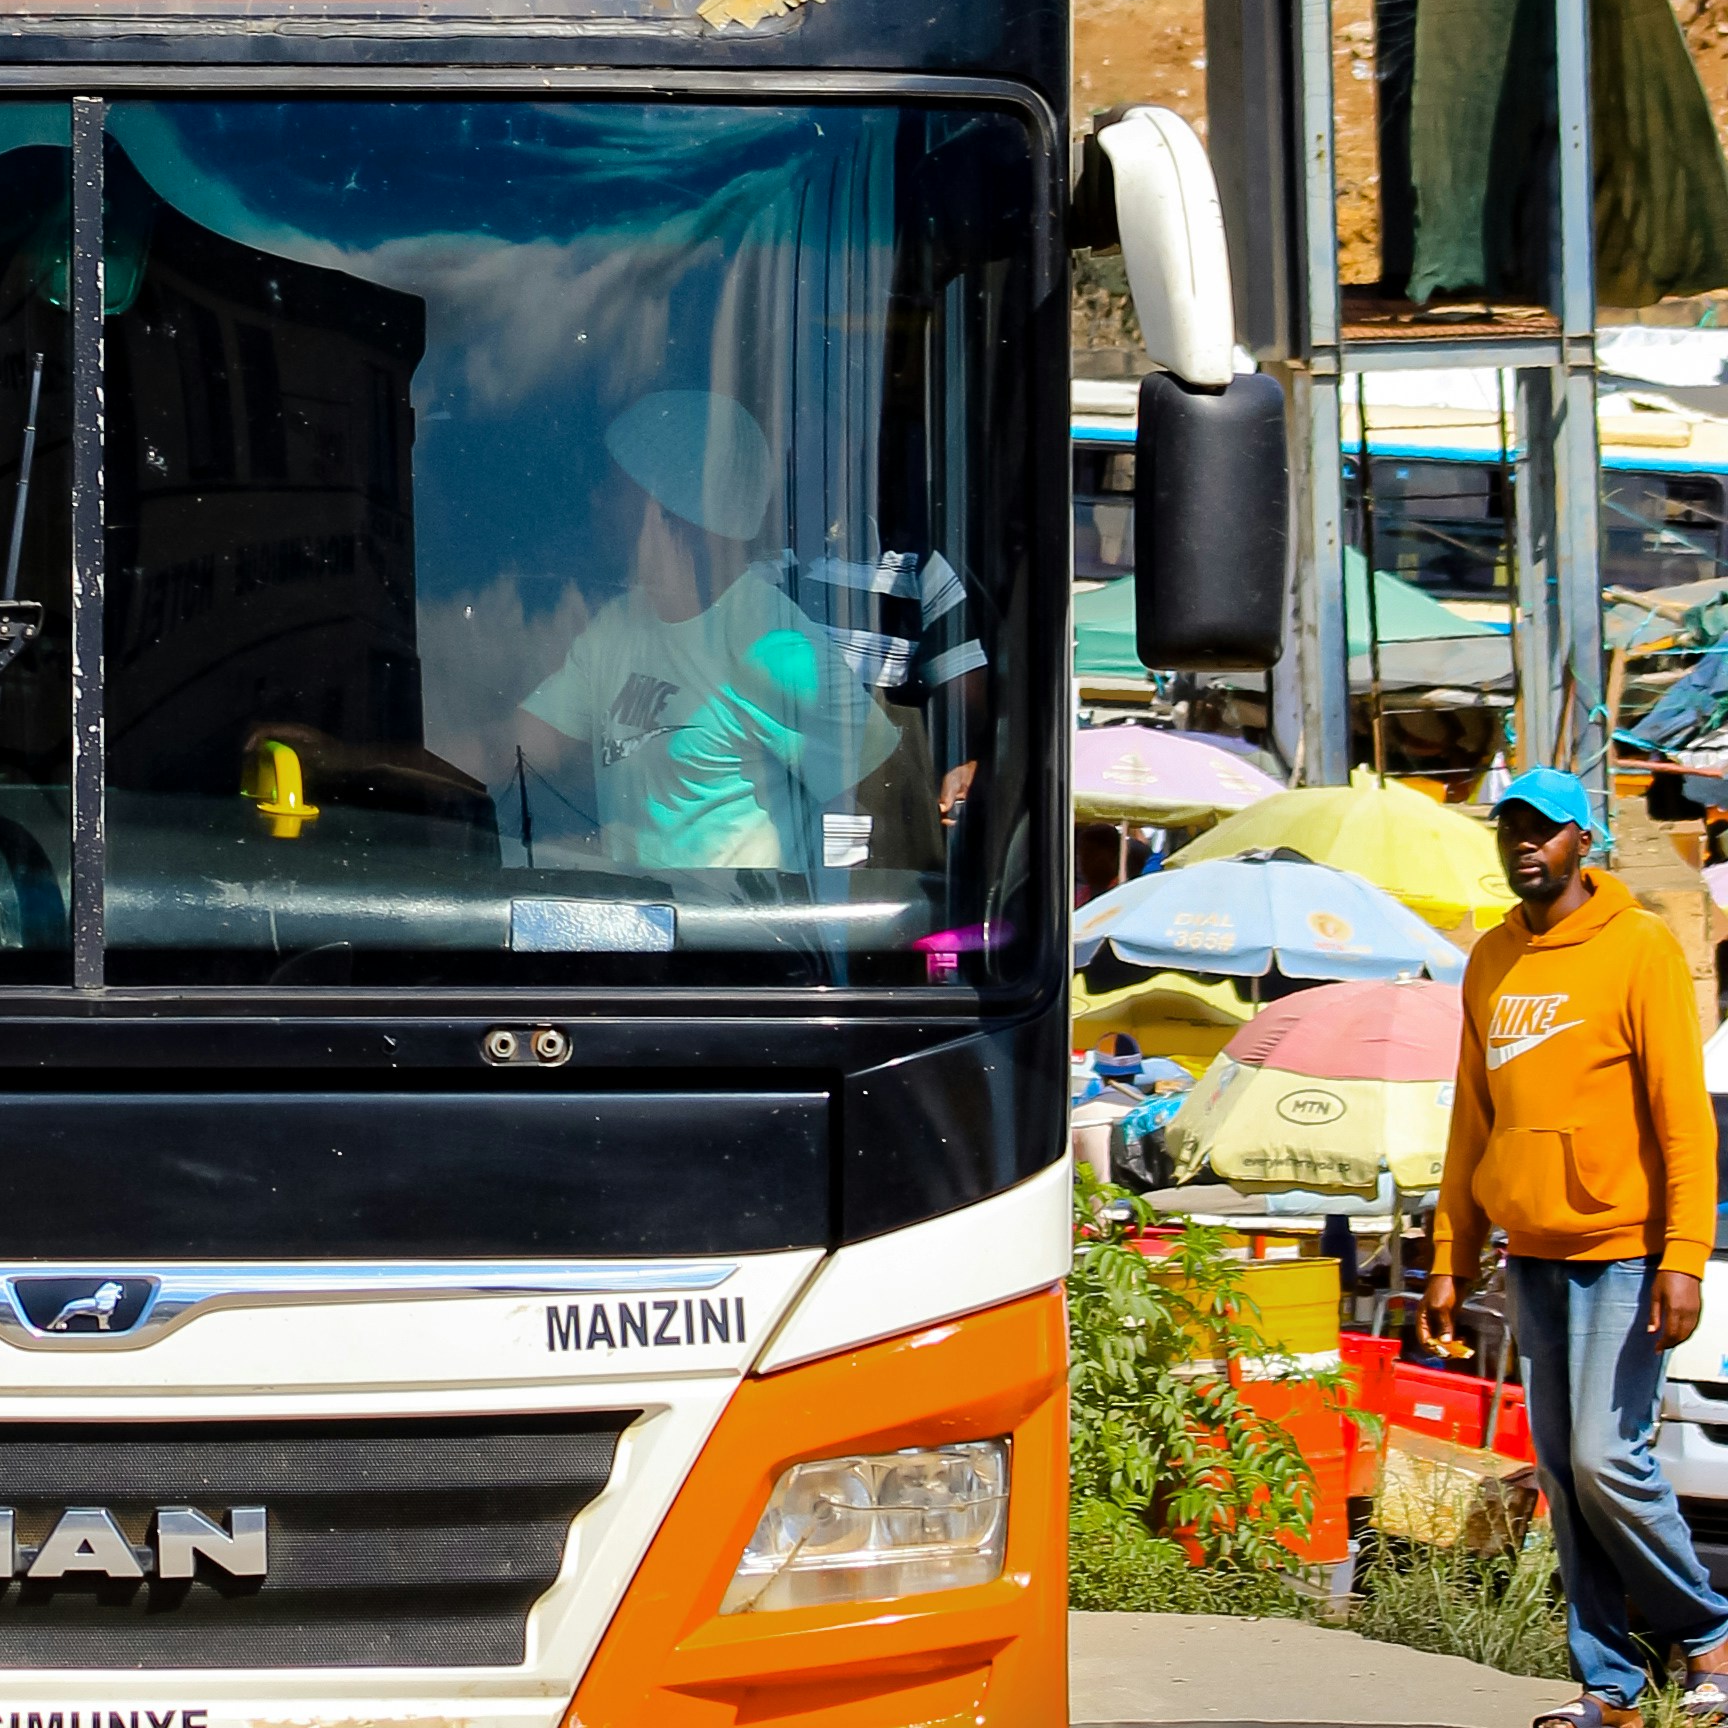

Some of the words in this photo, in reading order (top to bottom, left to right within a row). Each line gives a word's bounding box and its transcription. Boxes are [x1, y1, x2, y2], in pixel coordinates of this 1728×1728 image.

[611, 672, 680, 732] NIKE
[1489, 994, 1563, 1036] NIKE
[1292, 1100, 1330, 1116] MTN
[546, 1296, 747, 1353] MANZINI
